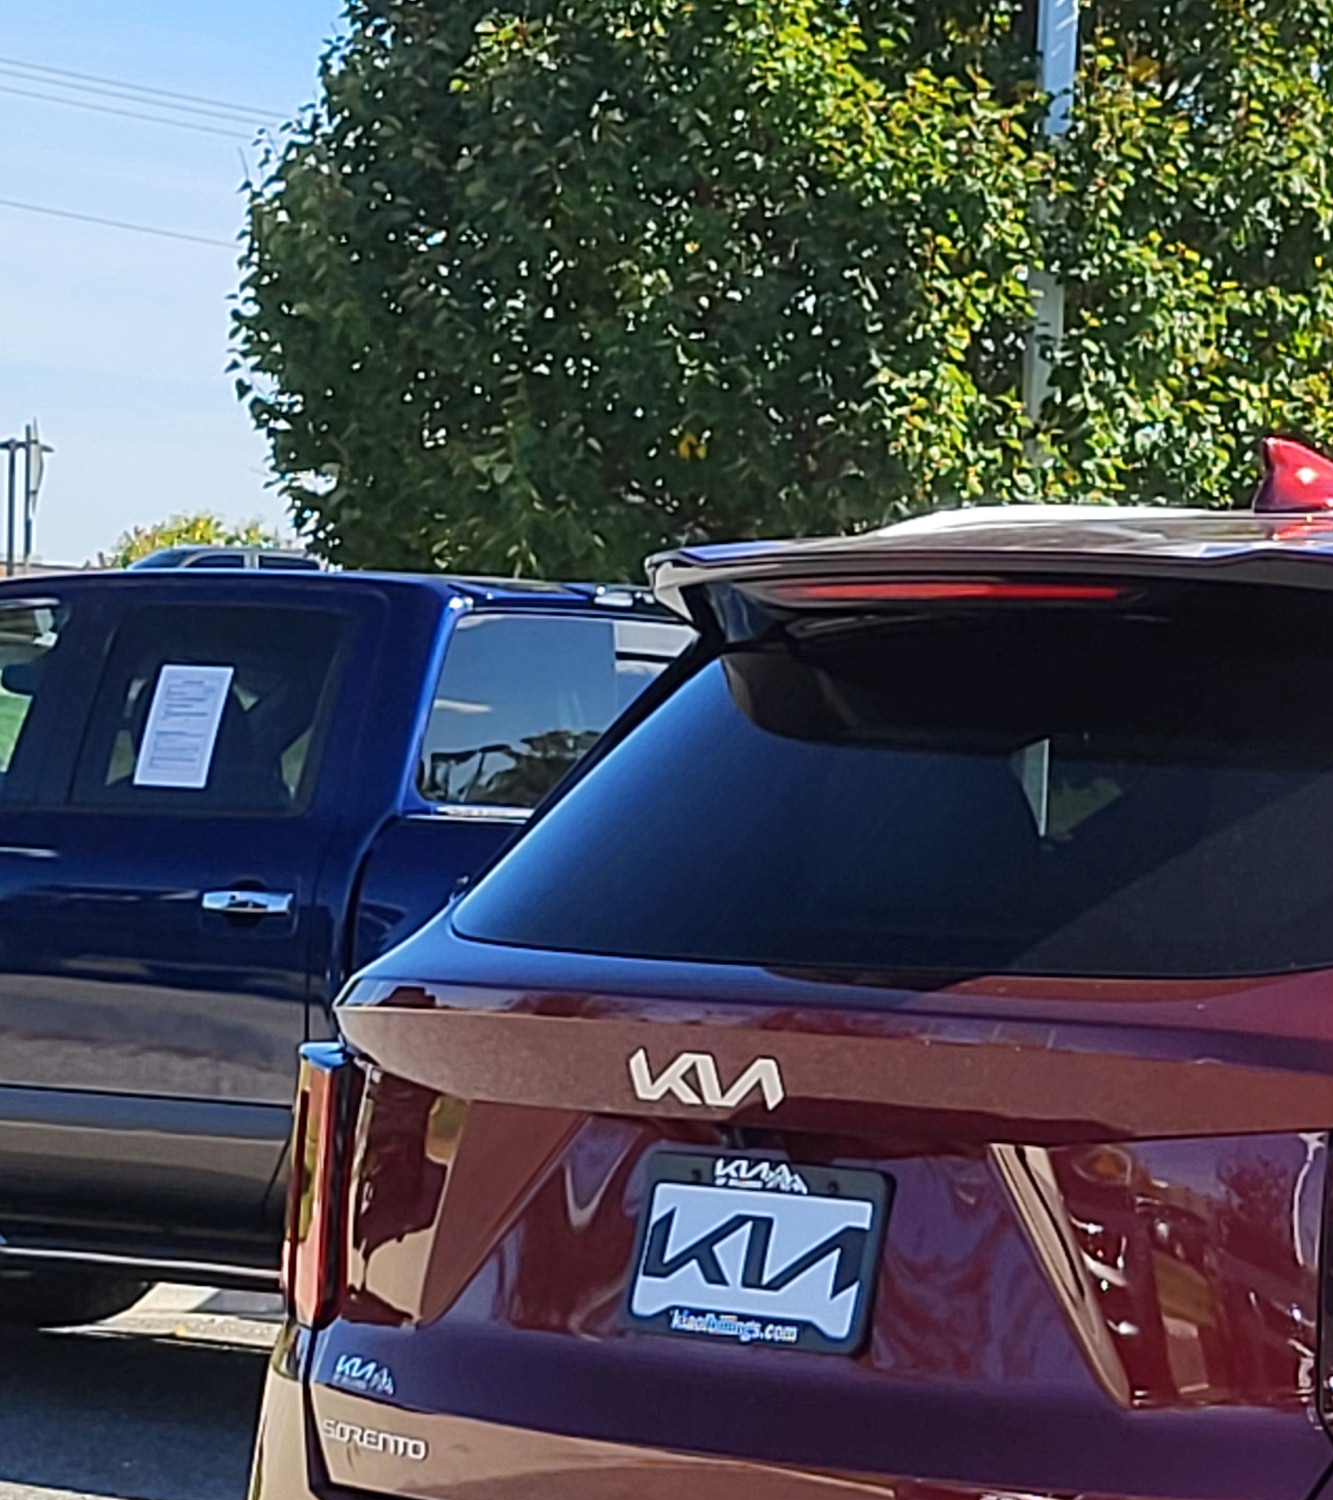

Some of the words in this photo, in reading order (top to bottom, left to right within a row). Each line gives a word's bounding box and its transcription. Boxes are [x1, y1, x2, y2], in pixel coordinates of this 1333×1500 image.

[630, 1048, 785, 1111] KIA
[642, 1206, 866, 1300] KIA
[323, 1419, 427, 1460] SORENTO
